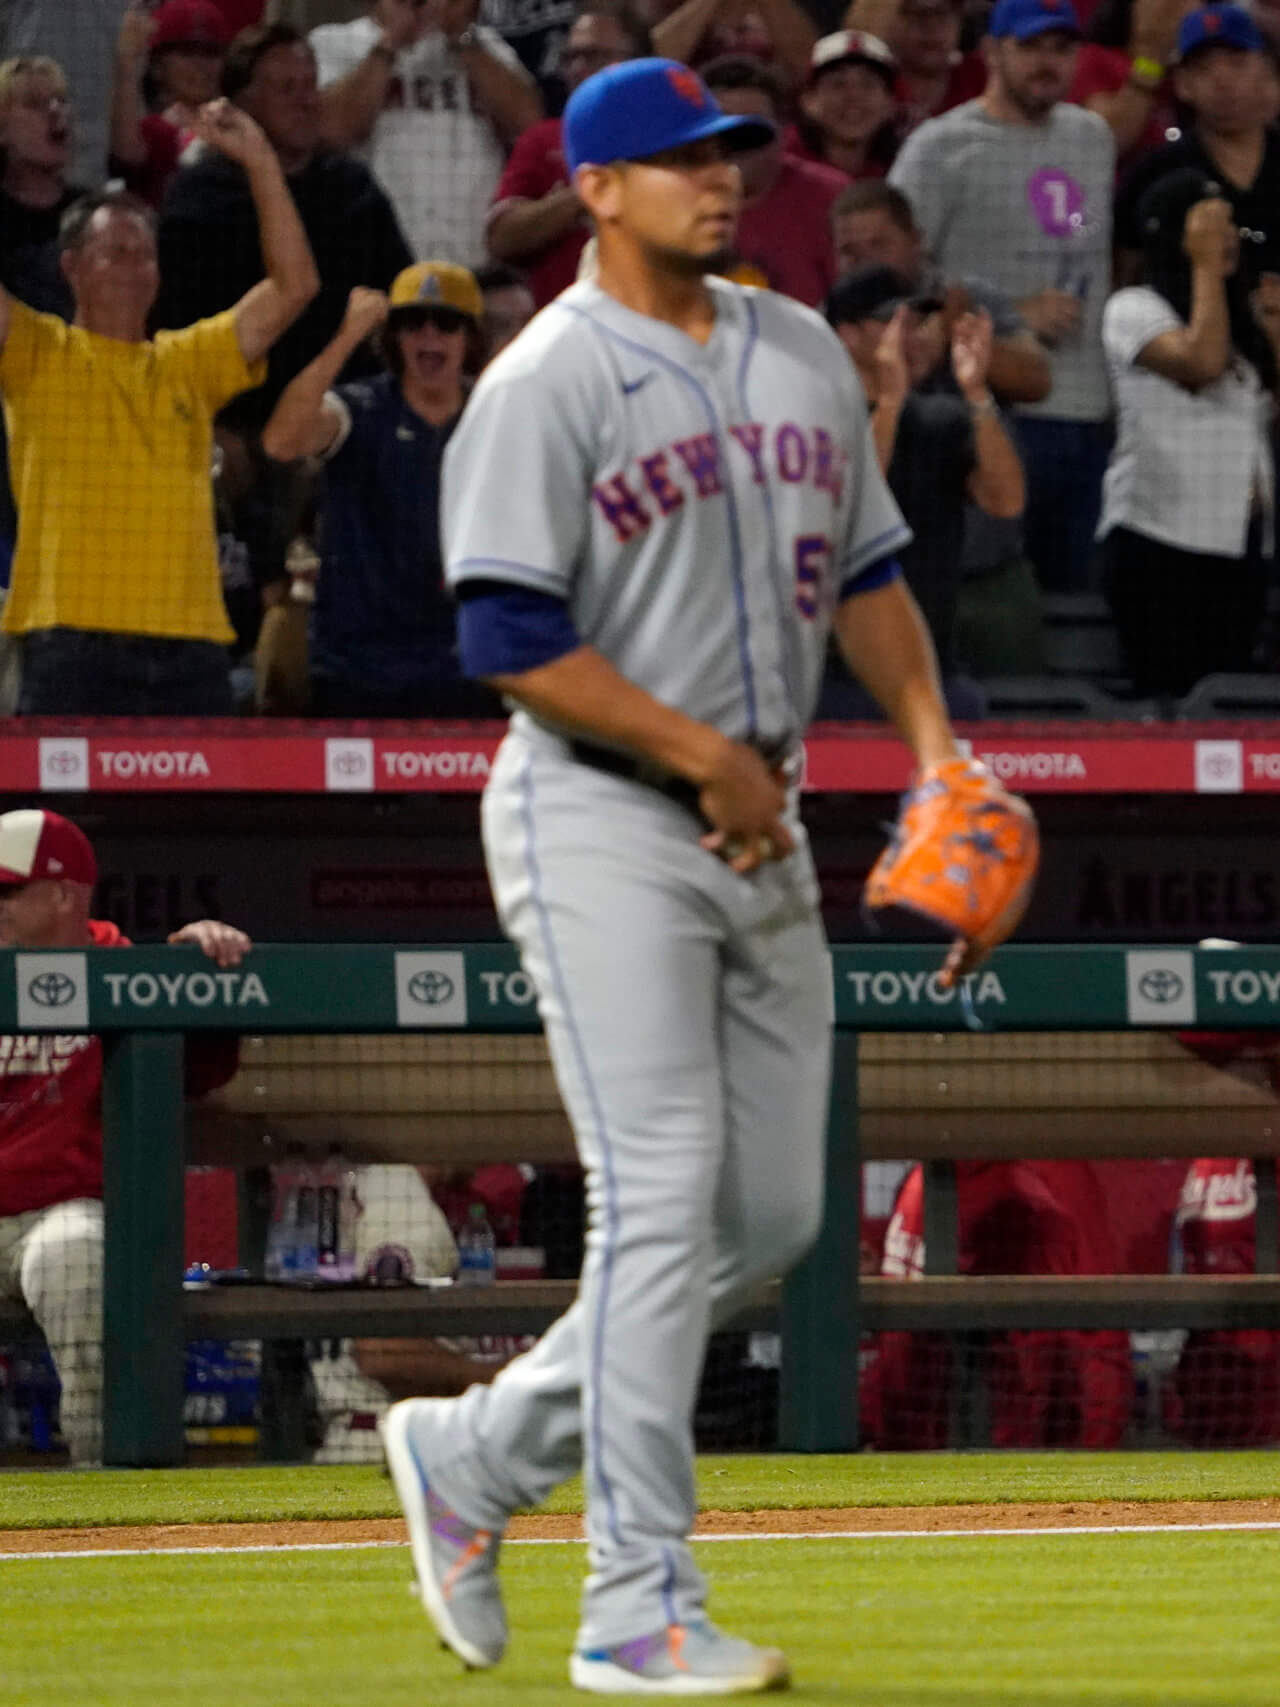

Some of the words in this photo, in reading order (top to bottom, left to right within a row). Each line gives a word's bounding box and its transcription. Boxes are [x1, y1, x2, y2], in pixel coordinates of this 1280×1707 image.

[593, 433, 723, 542] NEW
[98, 751, 210, 777] TOYOTA
[382, 751, 492, 777] TOYOTA
[980, 752, 1087, 779] TOYOTA
[104, 973, 269, 1007] TOYOTA
[848, 971, 1007, 1004] TOYOTA
